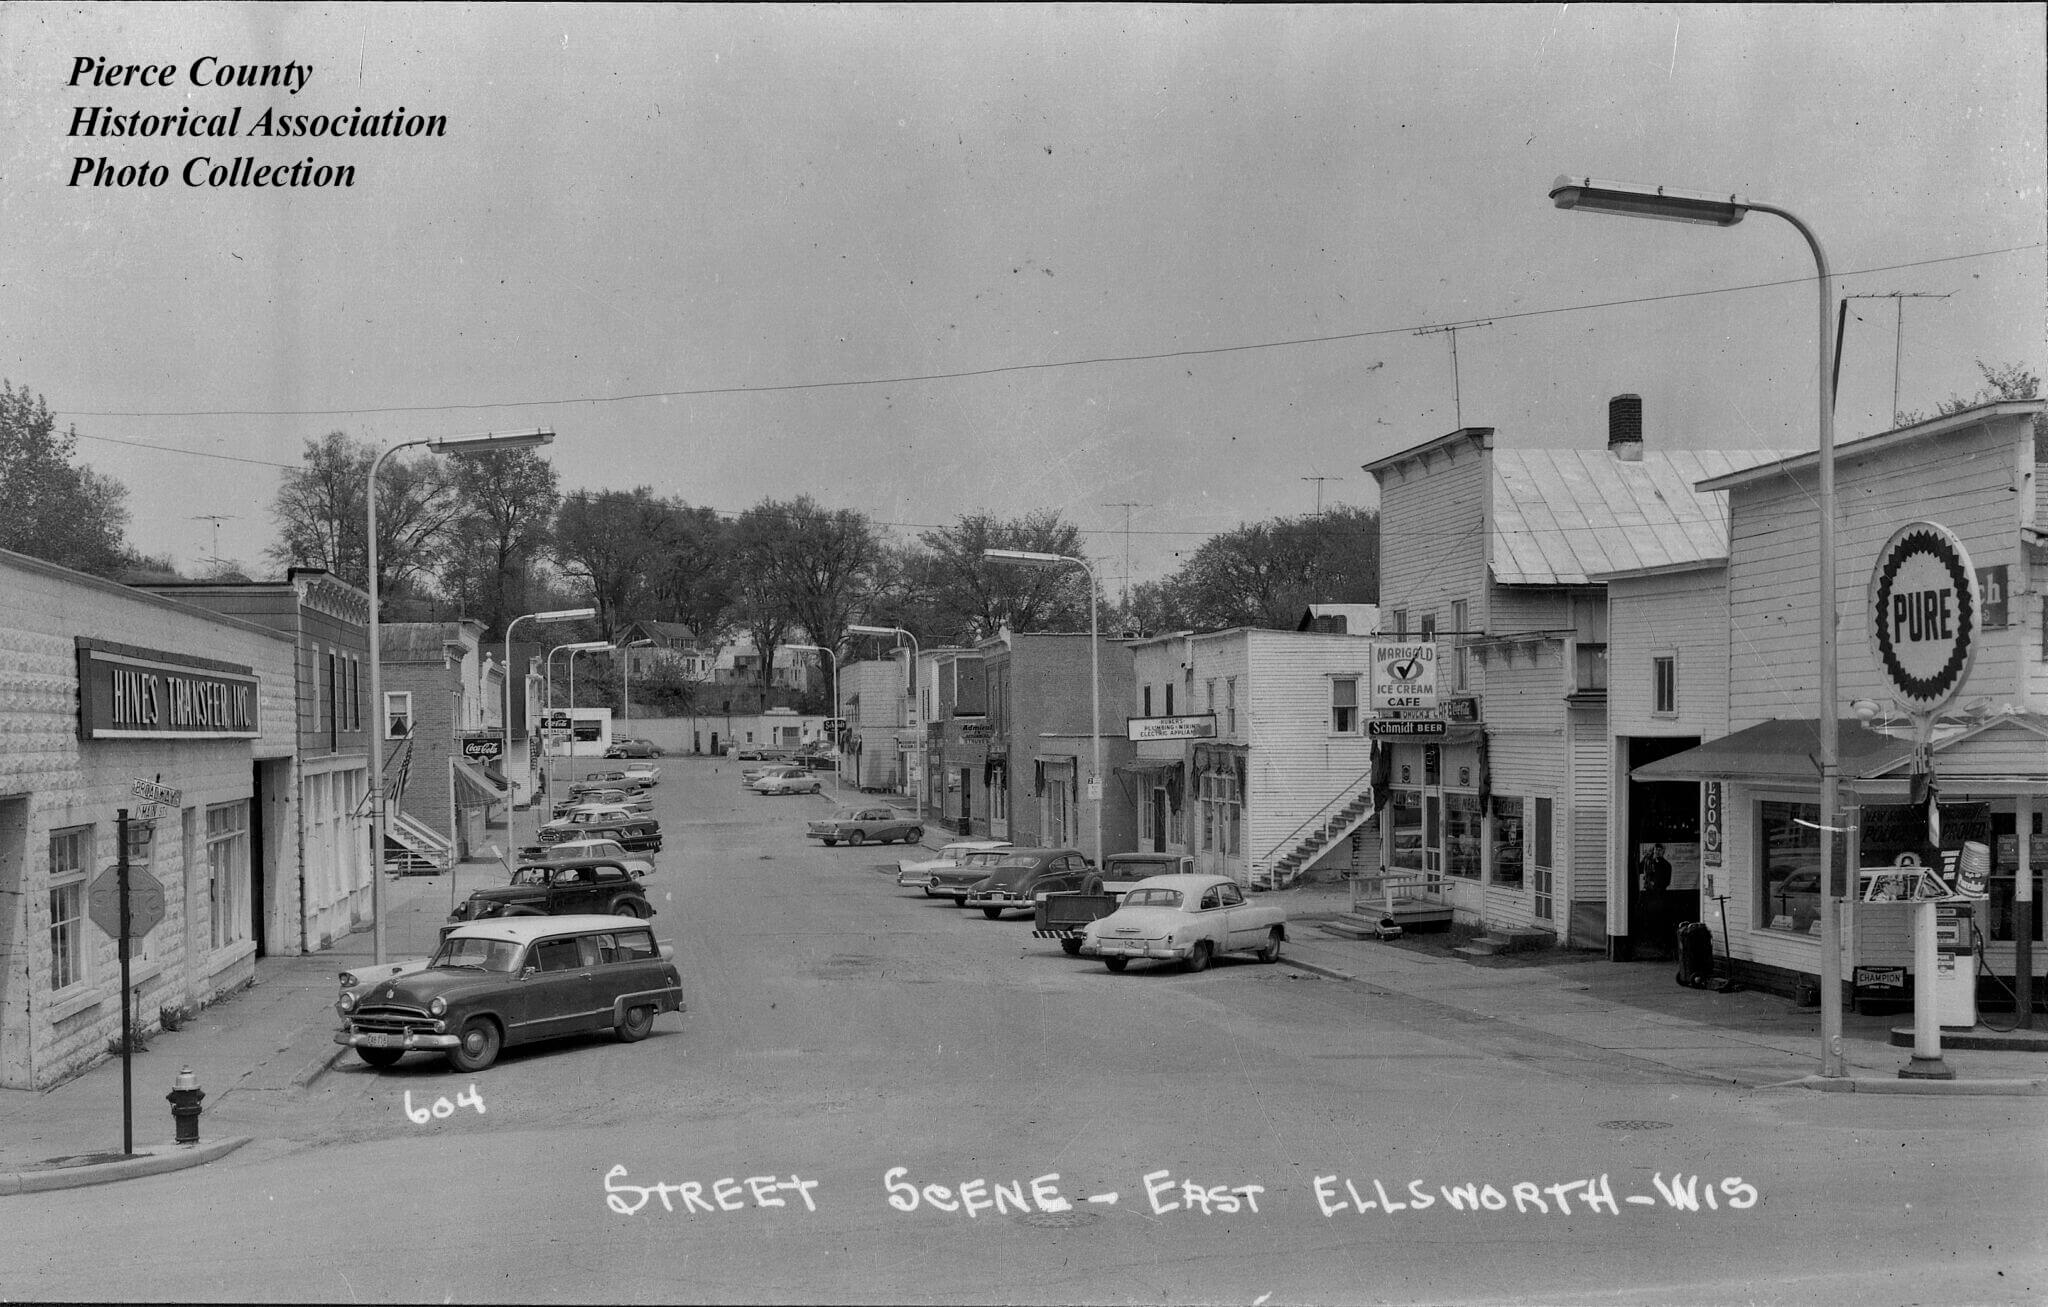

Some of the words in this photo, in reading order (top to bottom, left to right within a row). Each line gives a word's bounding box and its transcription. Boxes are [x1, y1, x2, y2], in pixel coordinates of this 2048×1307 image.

[1893, 588, 1953, 644] PURE
[1377, 647, 1433, 662] MARIGOLD
[1377, 684, 1393, 694] ICE
[1396, 684, 1433, 694] CREAM
[113, 669, 159, 725] HINES
[1387, 698, 1421, 707] CAFE
[1373, 721, 1414, 734] Schmidt
[1417, 724, 1443, 732] BEER
[136, 781, 176, 805] BROADWAY
[142, 805, 158, 818] MAIN
[1859, 972, 1901, 983] CHAMPION
